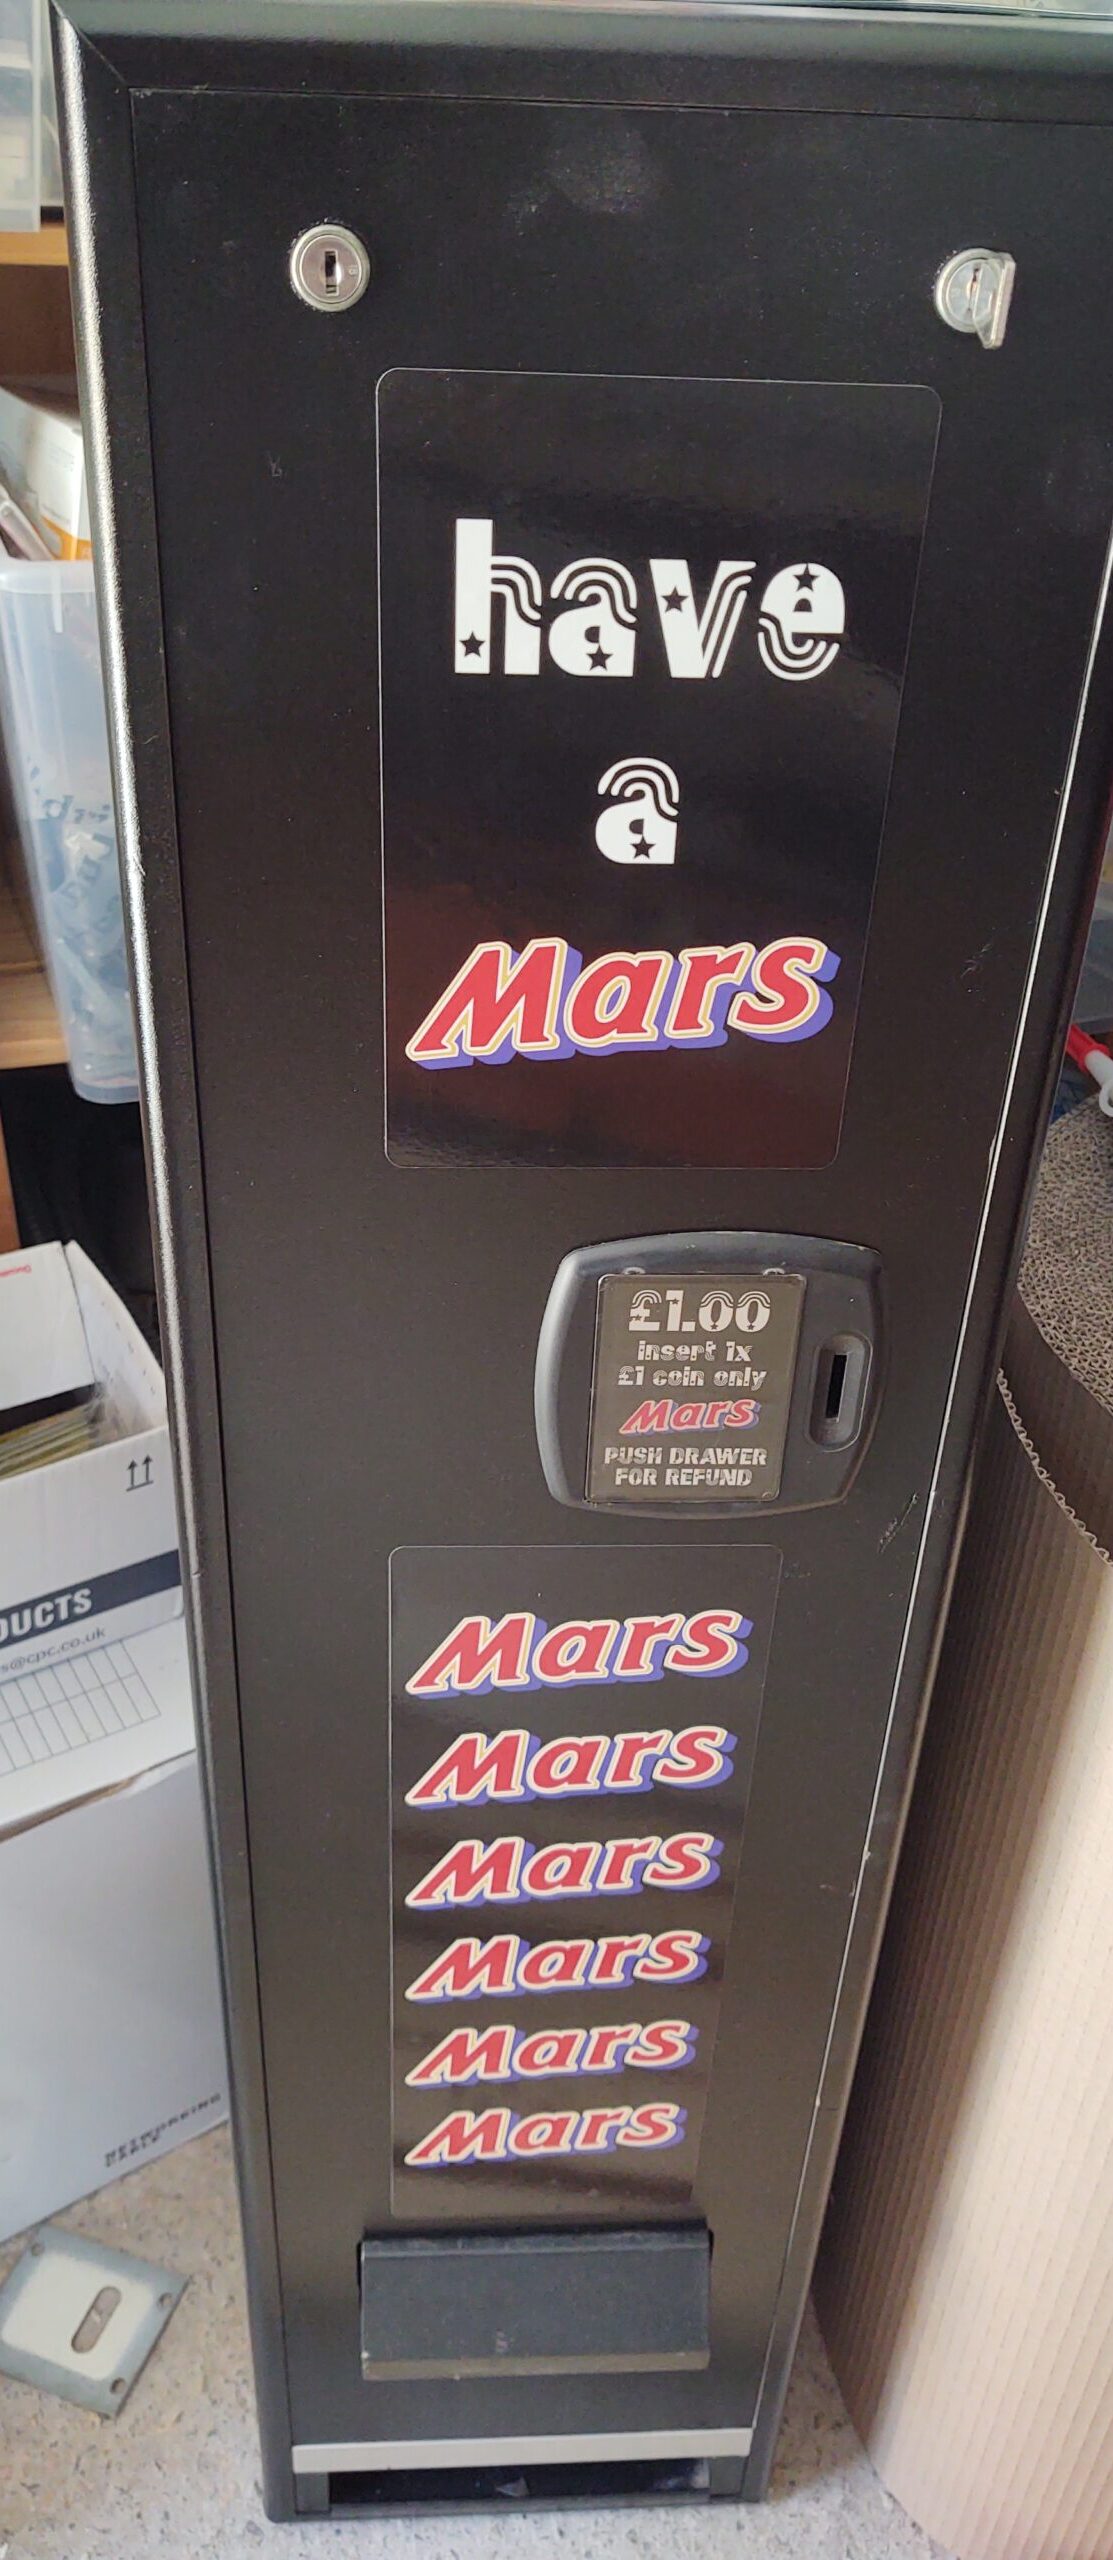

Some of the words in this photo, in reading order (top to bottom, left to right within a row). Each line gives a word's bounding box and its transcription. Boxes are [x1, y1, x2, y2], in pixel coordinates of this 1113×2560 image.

[455, 518, 846, 681] have
[595, 757, 680, 865] a
[405, 936, 842, 1070] Mars
[628, 1289, 771, 1333] £1.00
[617, 1365, 645, 1386] £1
[652, 1366, 704, 1387] coin
[713, 1367, 768, 1391] only
[637, 1340, 717, 1361] insert
[726, 1341, 752, 1361] 1x
[618, 1399, 761, 1436] Mars
[604, 1447, 663, 1465] PUSH
[669, 1447, 768, 1466] DRAWER
[615, 1468, 657, 1486] FOR
[665, 1468, 753, 1486] REFUND
[405, 1609, 754, 1700] Mars
[404, 1725, 738, 1812] Mars
[404, 1832, 725, 1911] Mars
[404, 1930, 711, 2004] Mars
[404, 2020, 699, 2090] Mars
[404, 2103, 688, 2169] Mars
